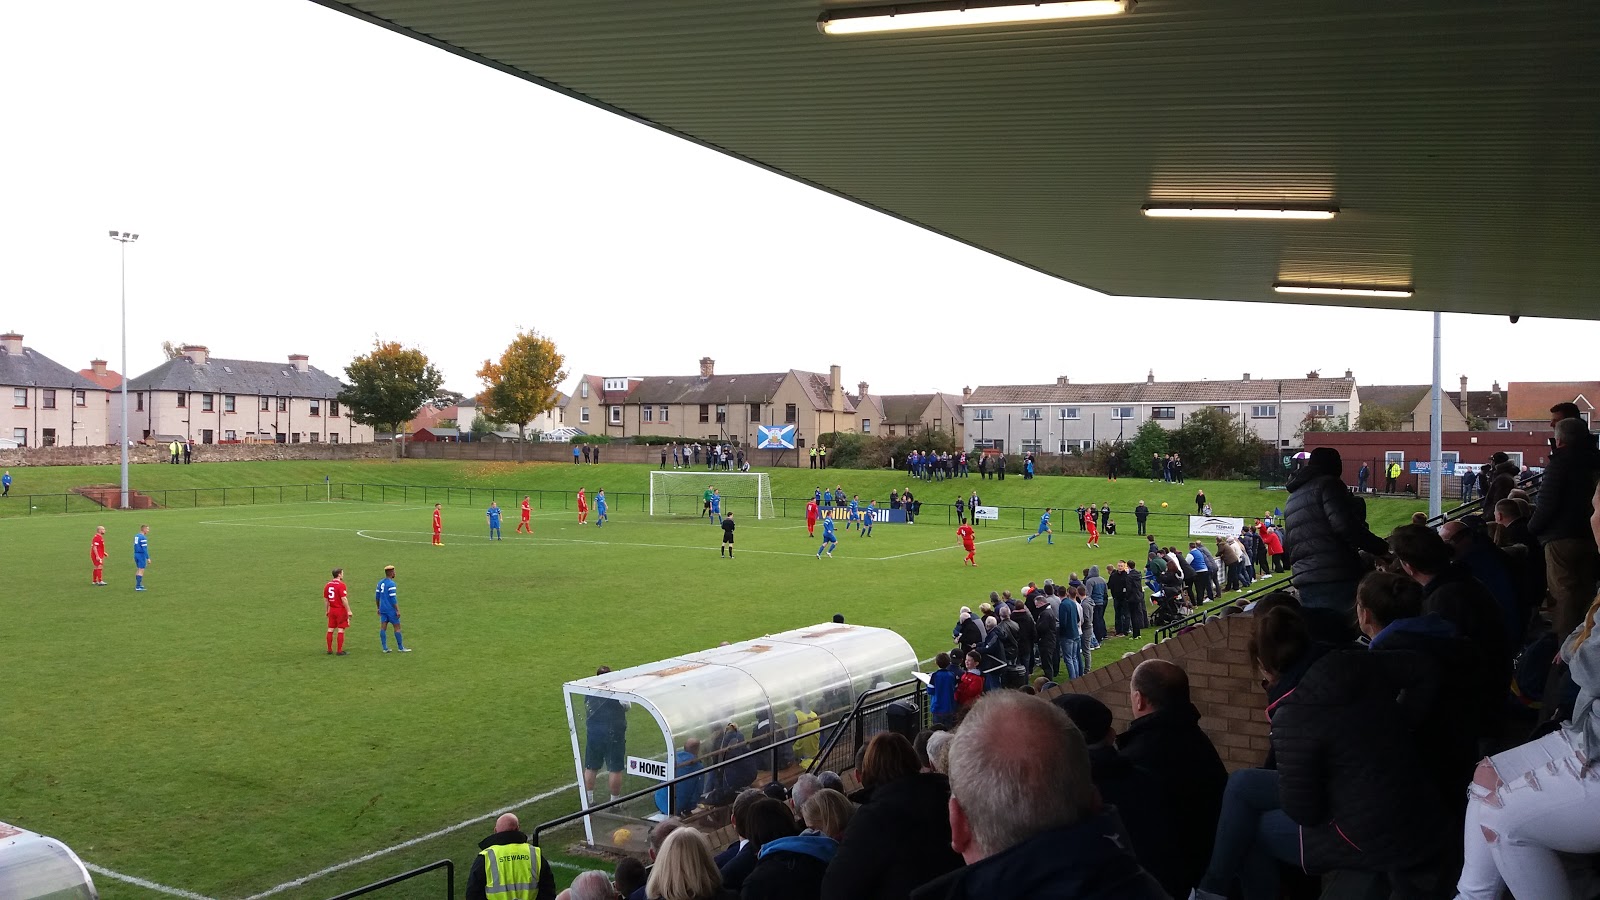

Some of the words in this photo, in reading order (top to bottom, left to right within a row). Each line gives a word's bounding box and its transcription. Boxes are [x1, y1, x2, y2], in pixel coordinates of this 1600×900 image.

[328, 587, 335, 599] 5
[380, 582, 385, 593] 9
[639, 761, 666, 777] HOME
[499, 855, 529, 863] STEWARD
